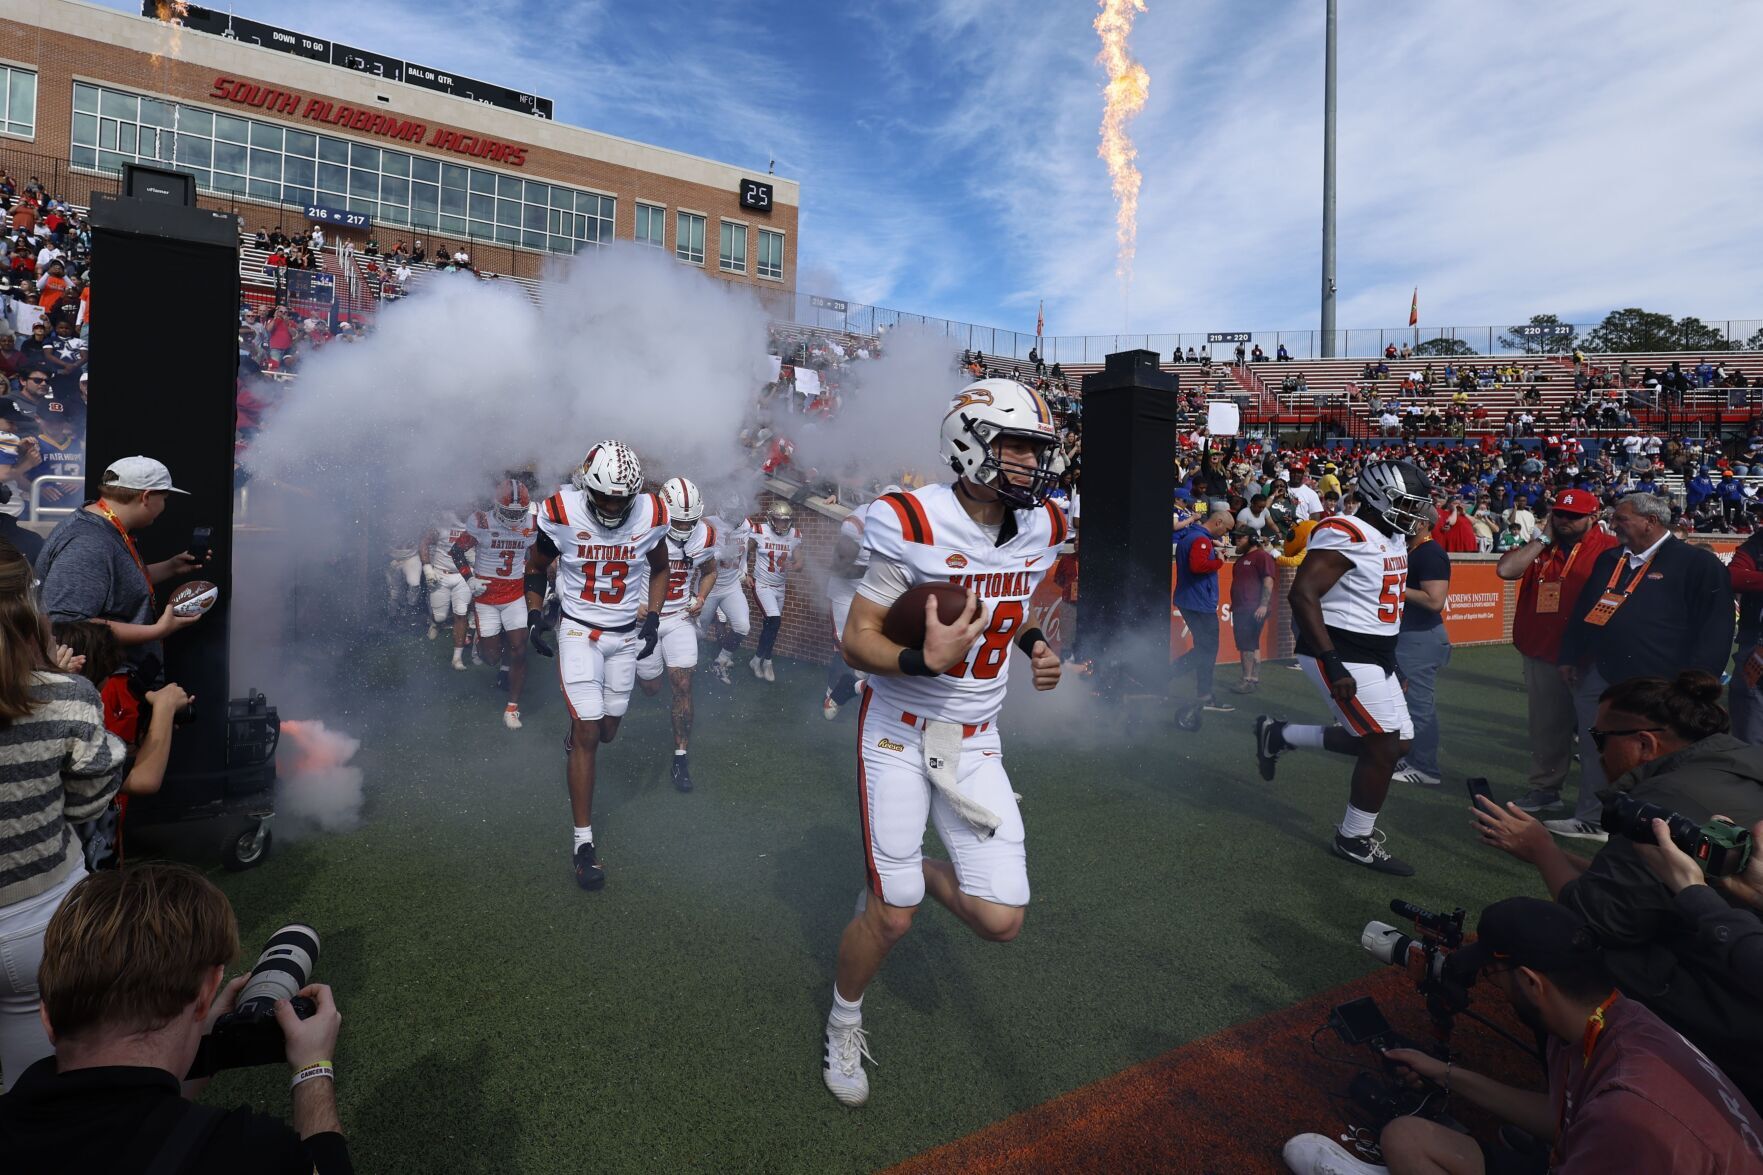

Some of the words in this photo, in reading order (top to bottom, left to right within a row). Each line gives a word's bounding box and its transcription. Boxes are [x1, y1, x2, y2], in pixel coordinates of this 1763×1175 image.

[272, 31, 296, 45] DOWN
[302, 39, 312, 49] TO
[312, 41, 324, 52] GO
[408, 67, 424, 79] BALL
[425, 71, 435, 81] ON
[519, 94, 534, 106] NFC
[209, 76, 301, 115] SOUTH
[303, 99, 427, 143] ALABAMA
[426, 128, 529, 167] JAGUARS
[747, 184, 768, 206] 25
[308, 207, 327, 219] 216
[346, 214, 365, 225] 217
[834, 302, 845, 310] 219
[1210, 334, 1223, 342] 219
[1524, 327, 1541, 335] 220
[576, 544, 637, 560] NATIONAL
[495, 550, 516, 577] 3
[579, 560, 630, 605] 13
